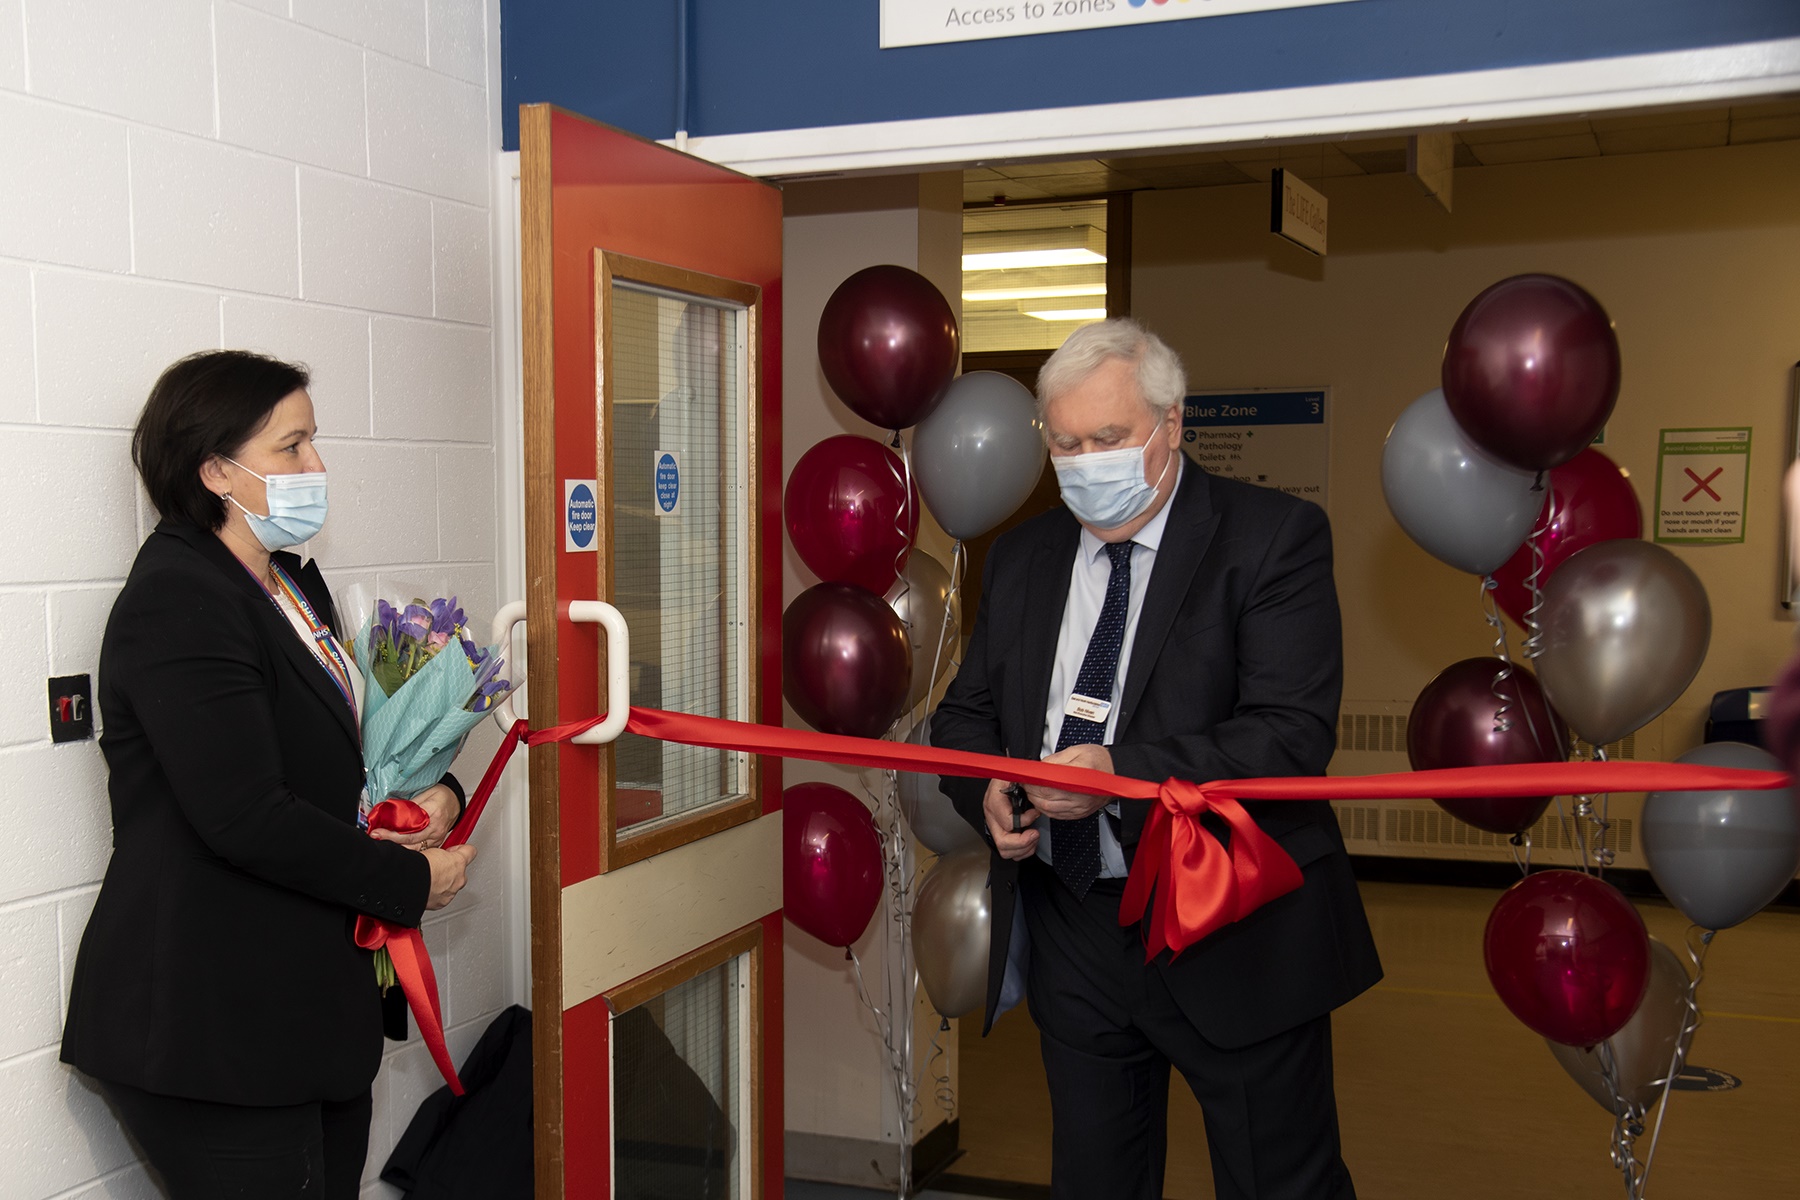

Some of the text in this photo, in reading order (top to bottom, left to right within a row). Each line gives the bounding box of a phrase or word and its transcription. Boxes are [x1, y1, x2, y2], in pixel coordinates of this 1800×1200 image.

[946, 0, 1116, 27] Access to zones
[1185, 404, 1258, 418] Blue Zone
[1311, 402, 1320, 415] 3
[1199, 431, 1242, 441] Pharmacy
[1199, 441, 1243, 451] Pathology
[1685, 444, 1714, 452] touching
[1199, 453, 1226, 462] Toilets
[659, 462, 677, 470] Automatic
[667, 472, 676, 480] door
[658, 482, 667, 490] keep
[1282, 486, 1302, 494] way
[1304, 485, 1320, 493] out
[671, 491, 676, 499] at
[569, 499, 595, 509] Automatic
[663, 501, 673, 509] night
[571, 511, 593, 520] fire door
[569, 522, 595, 533] Keep clear
[312, 628, 330, 641] NHS
